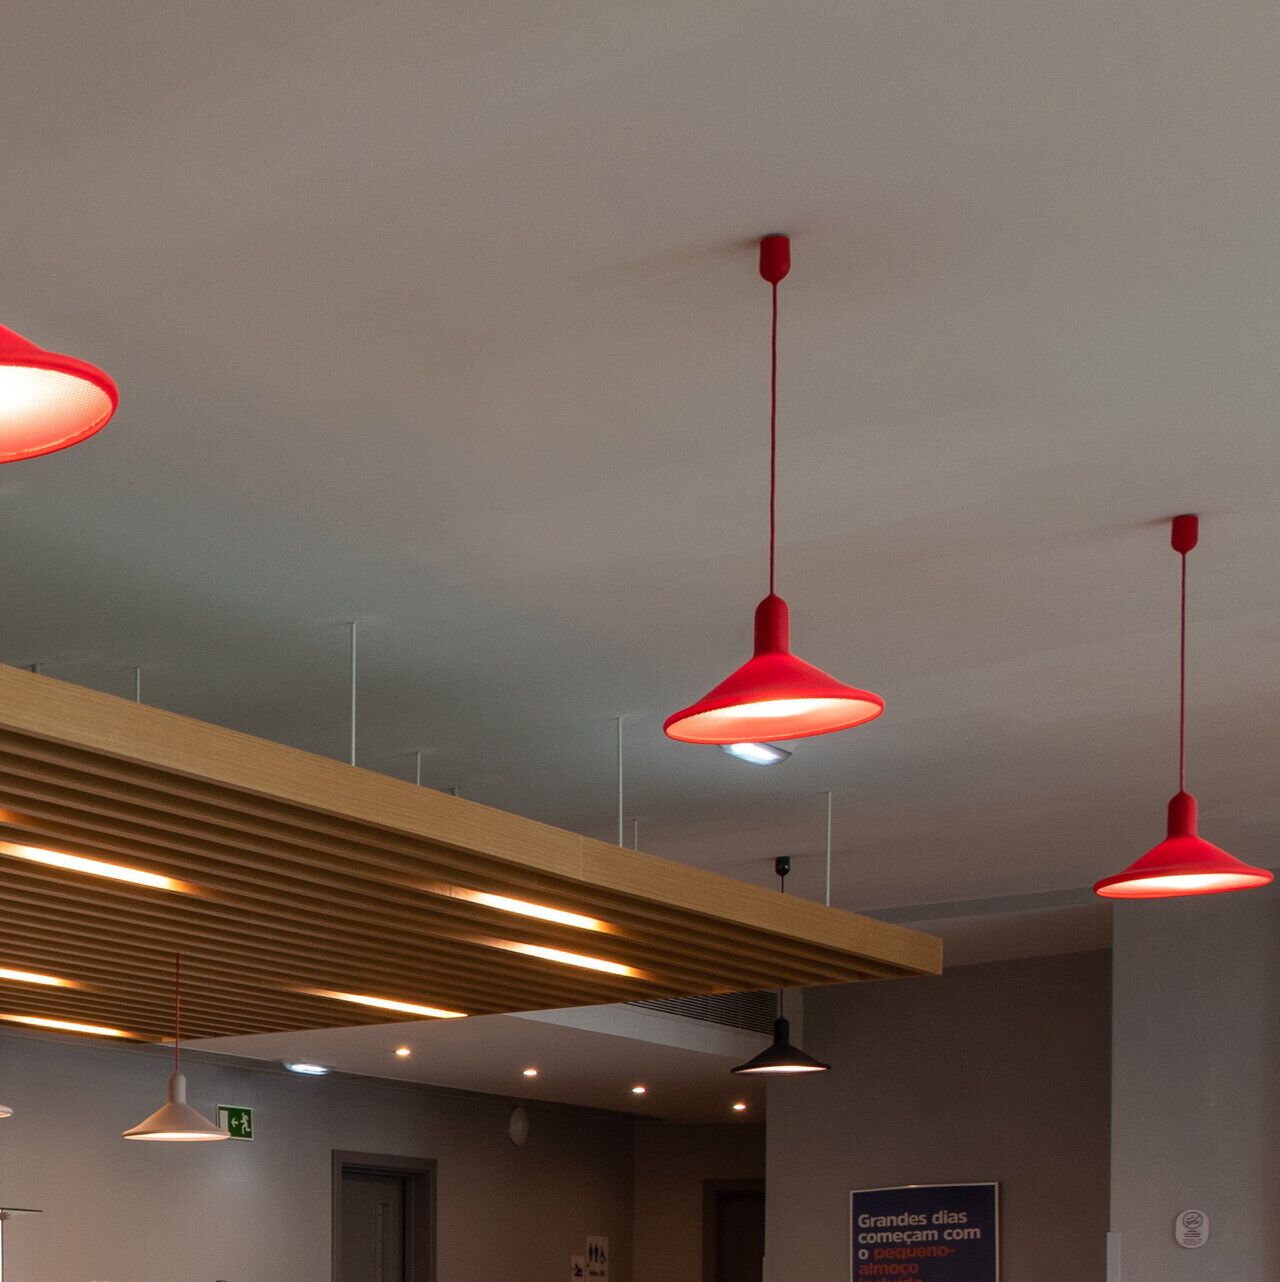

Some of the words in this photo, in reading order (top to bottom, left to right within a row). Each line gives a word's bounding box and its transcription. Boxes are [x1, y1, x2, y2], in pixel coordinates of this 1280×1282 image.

[858, 1213, 927, 1227] Grandes
[932, 1210, 968, 1224] dias
[858, 1230, 938, 1244] começam
[943, 1227, 981, 1240] com
[858, 1248, 868, 1260] o
[873, 1246, 956, 1261] pequeno-
[859, 1263, 918, 1277] almoço
